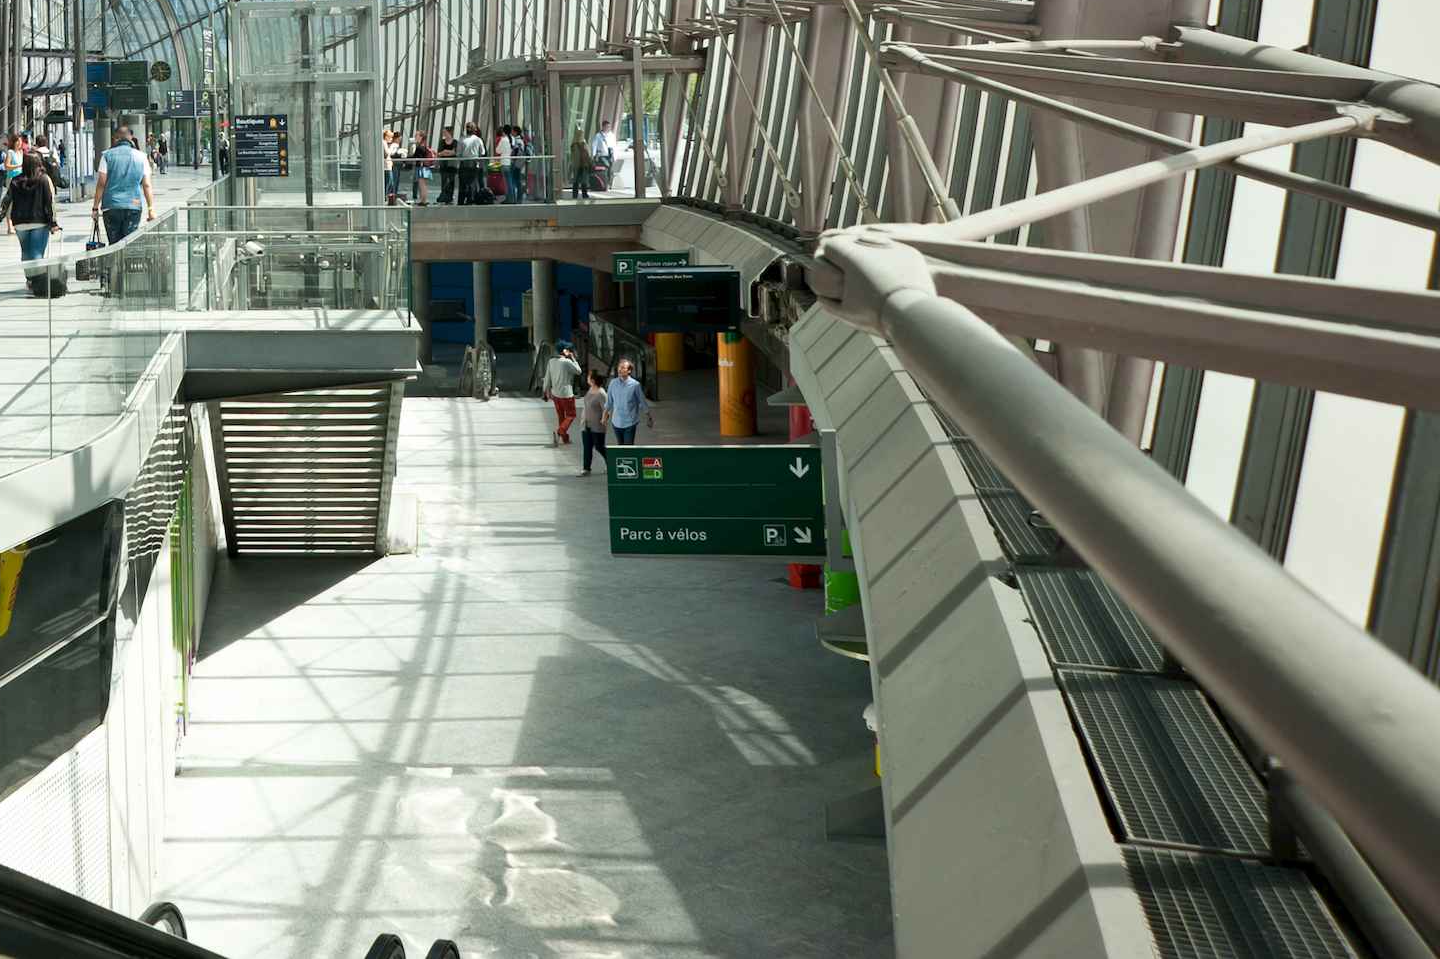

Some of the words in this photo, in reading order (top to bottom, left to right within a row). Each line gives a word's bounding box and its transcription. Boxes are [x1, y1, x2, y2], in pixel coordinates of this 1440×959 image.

[619, 261, 628, 273] P
[654, 458, 661, 467] A
[655, 469, 661, 479] D
[620, 528, 651, 540] Parc
[656, 528, 664, 540] à
[668, 527, 707, 541] vélos
[766, 527, 779, 543] P
